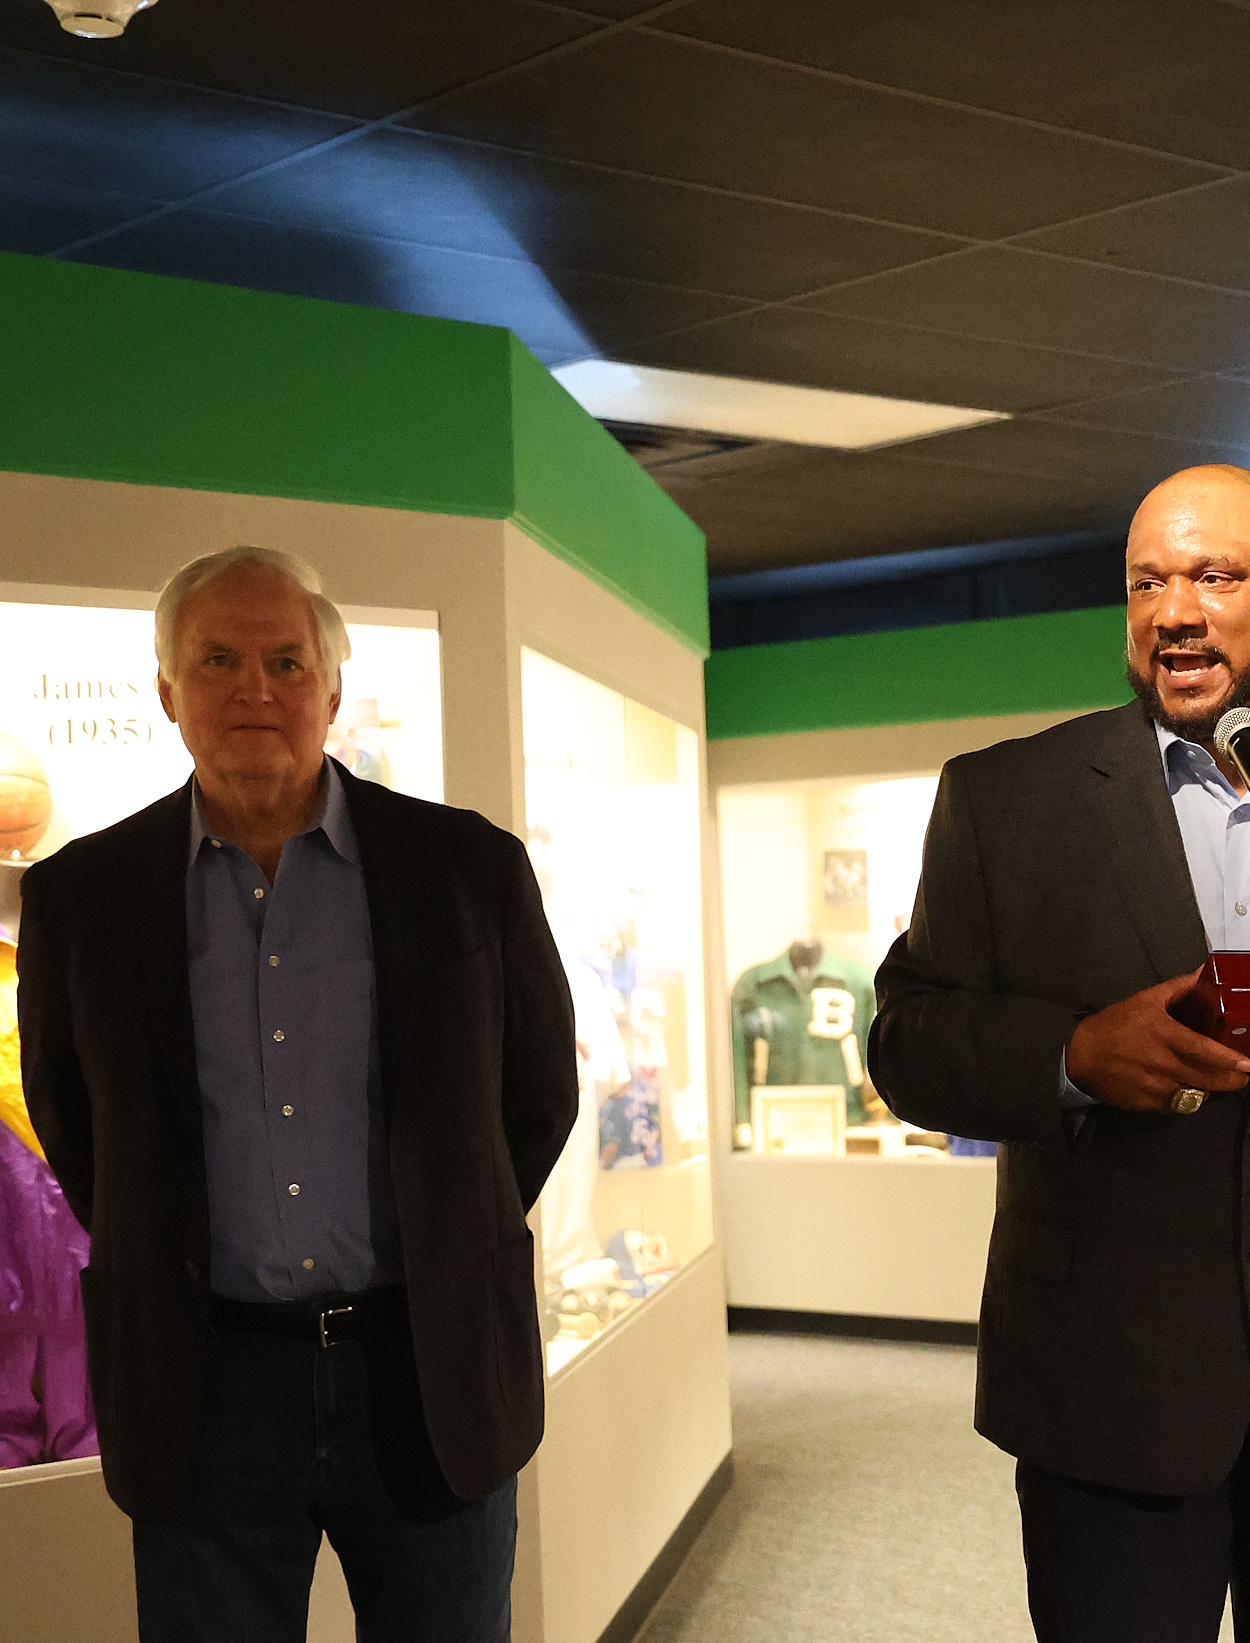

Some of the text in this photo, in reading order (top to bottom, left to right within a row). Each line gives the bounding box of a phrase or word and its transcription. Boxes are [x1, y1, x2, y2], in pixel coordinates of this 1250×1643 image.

[34, 674, 139, 700] James
[49, 718, 152, 747] (1935)
[808, 988, 855, 1040] B
